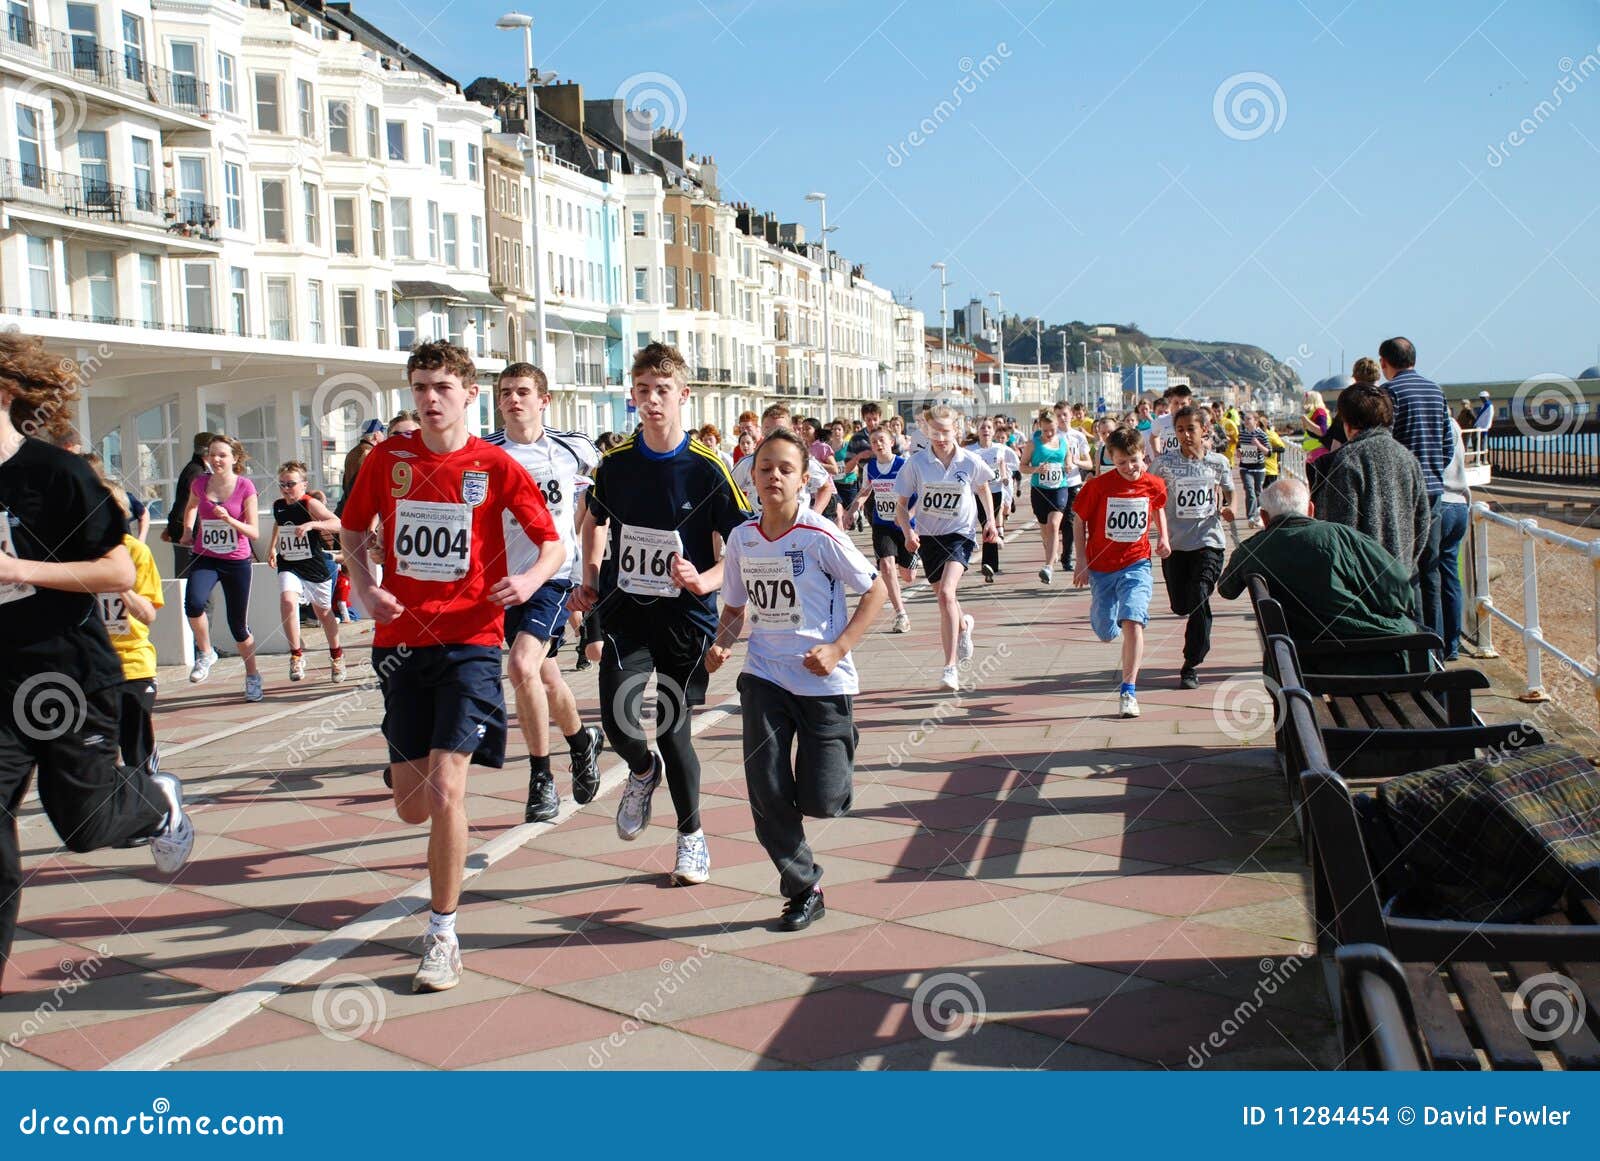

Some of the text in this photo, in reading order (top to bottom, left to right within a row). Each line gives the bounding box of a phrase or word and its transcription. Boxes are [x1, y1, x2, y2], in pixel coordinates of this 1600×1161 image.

[391, 461, 413, 498] 9
[877, 500, 898, 513] 609
[923, 492, 962, 509] 6027
[1177, 488, 1214, 507] 6204
[1107, 511, 1147, 529] 6003
[203, 528, 235, 545] 6091
[280, 536, 309, 551] 6144
[396, 524, 469, 560] 6004
[746, 579, 796, 609] 6079
